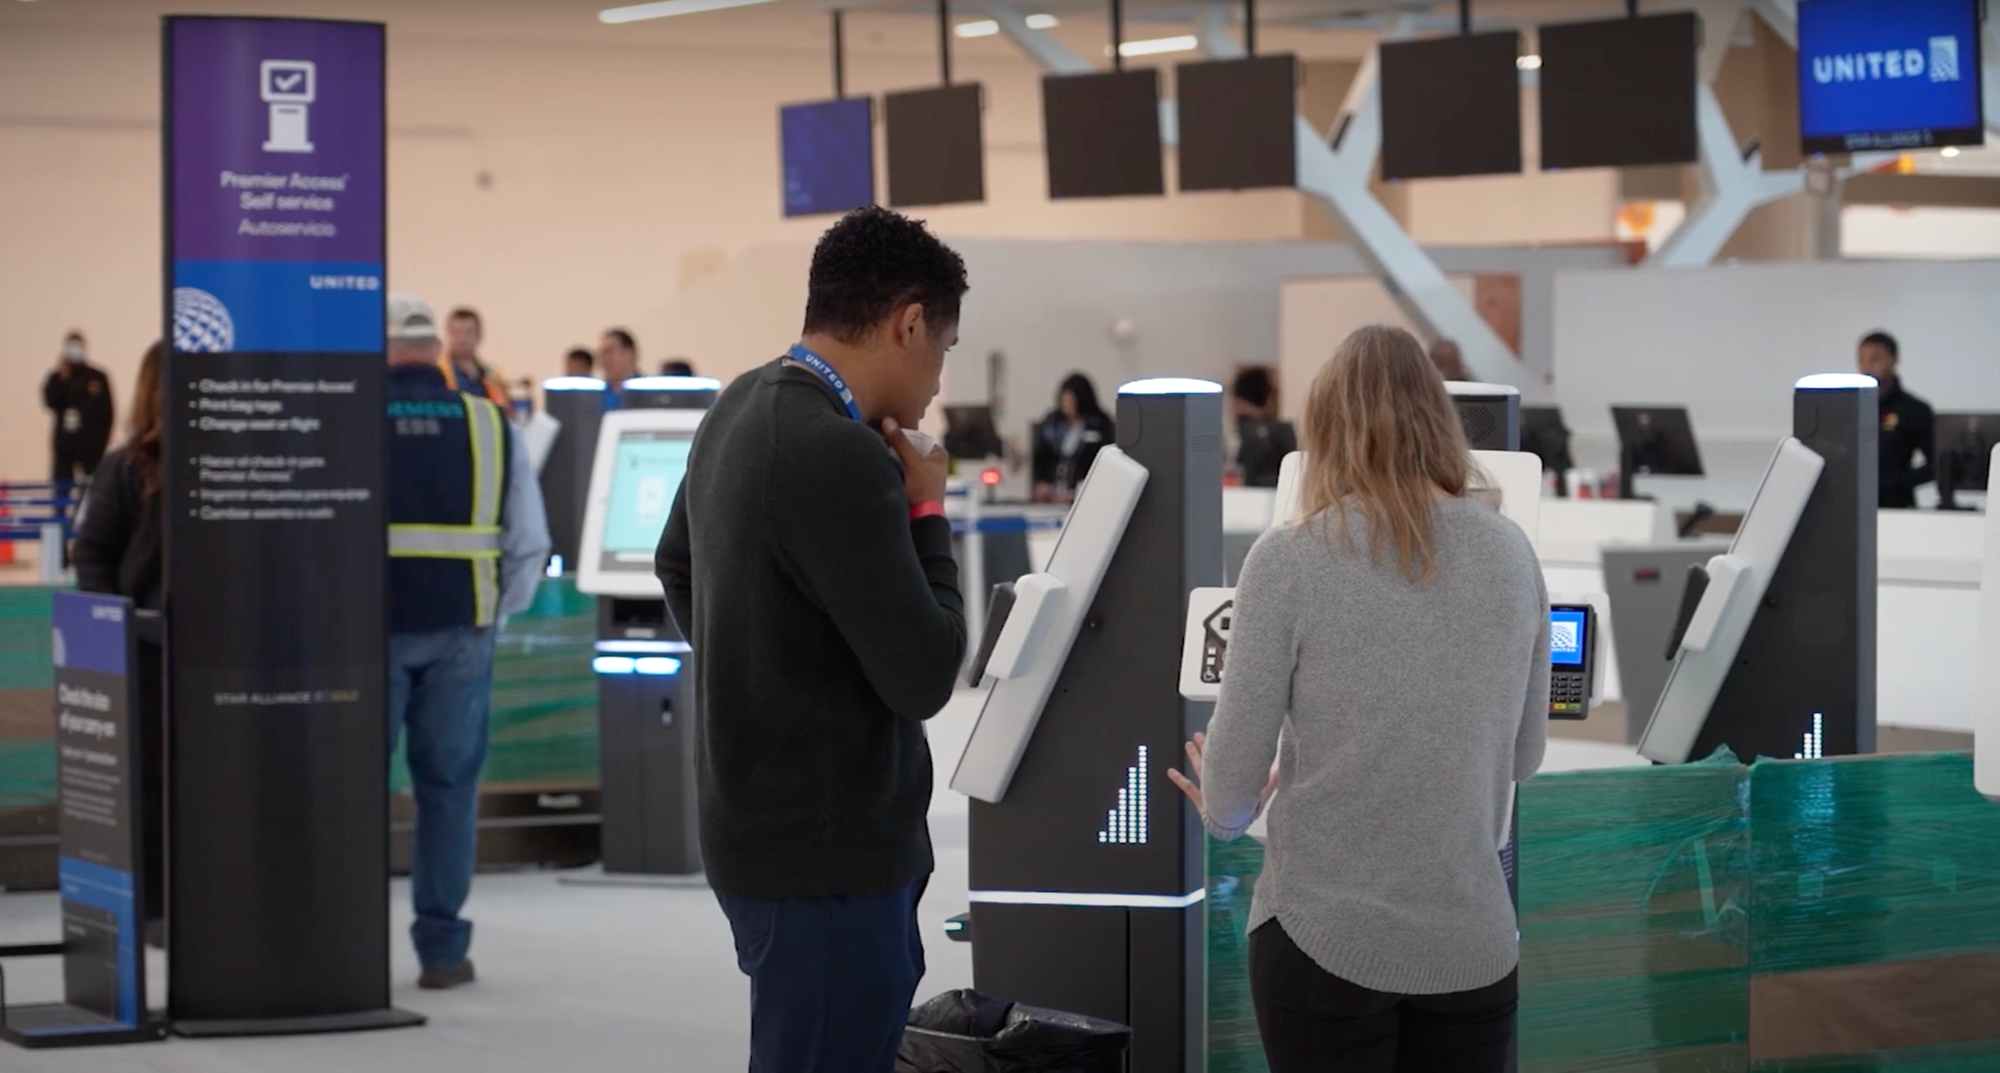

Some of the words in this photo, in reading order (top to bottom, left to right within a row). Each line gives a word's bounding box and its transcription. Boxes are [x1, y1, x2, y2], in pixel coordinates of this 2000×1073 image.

[1812, 48, 1925, 84] UNITED
[220, 170, 287, 189] Premier
[240, 191, 275, 210] Self
[276, 194, 334, 211] service
[238, 218, 337, 238] Autoservicio
[310, 275, 381, 290] UNITED
[805, 353, 844, 389] UNITED
[200, 378, 238, 394] Check
[200, 416, 248, 433] Change
